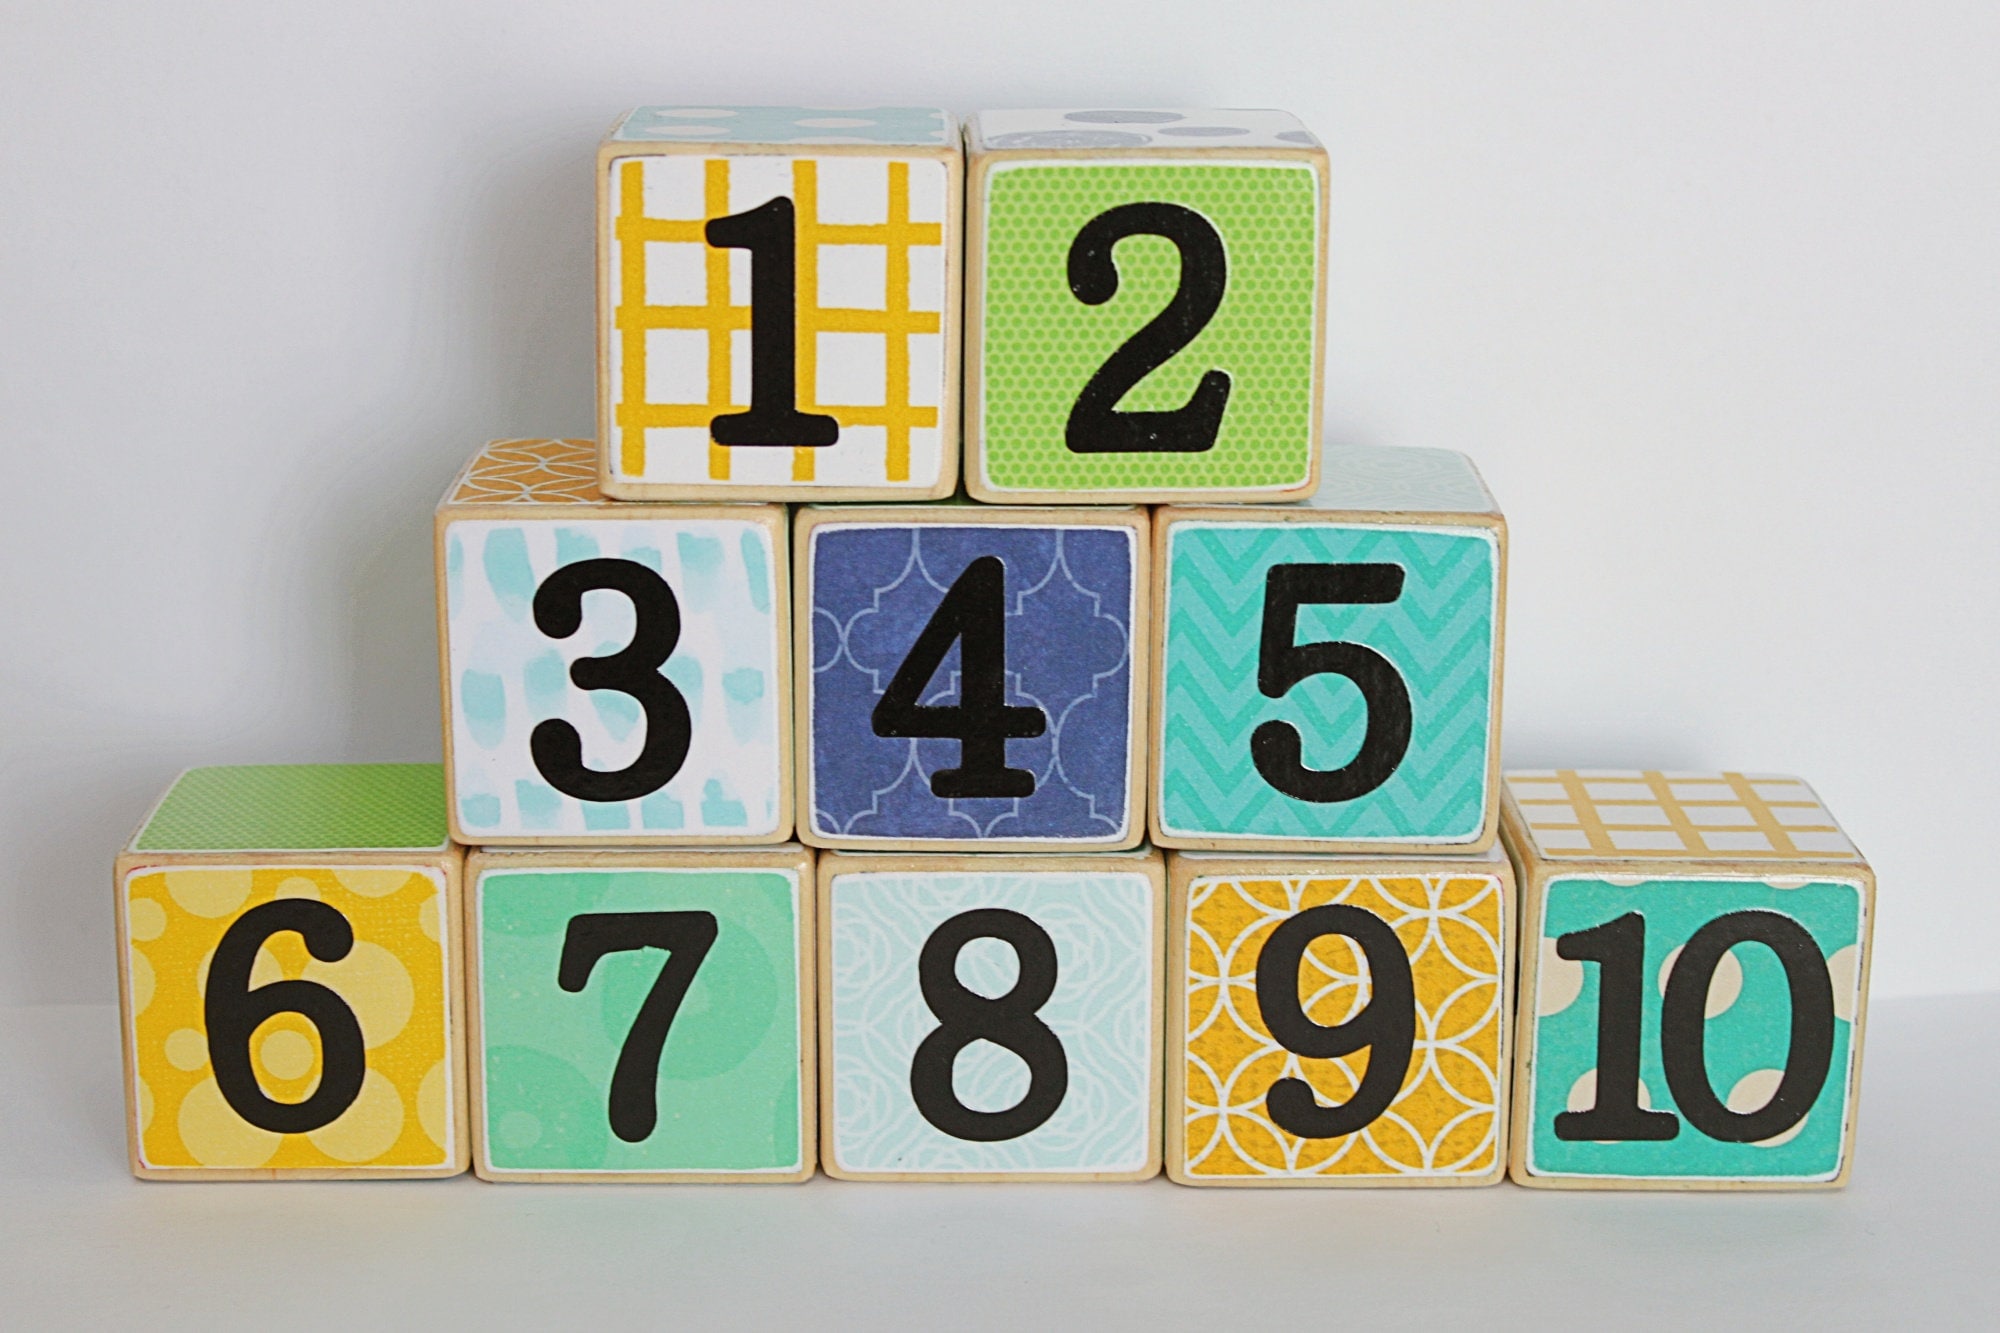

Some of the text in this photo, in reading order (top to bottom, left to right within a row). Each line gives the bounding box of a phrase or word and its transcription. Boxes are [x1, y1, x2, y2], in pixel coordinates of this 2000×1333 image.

[705, 196, 838, 447] 1
[1065, 202, 1231, 453] 2
[531, 557, 691, 802] 3
[871, 555, 1047, 798] 4
[1250, 562, 1413, 803] 5
[204, 898, 366, 1134] 6
[558, 910, 718, 1142] 7
[910, 908, 1068, 1142] 8
[1255, 904, 1416, 1139] 9
[1554, 910, 1835, 1143] 10
